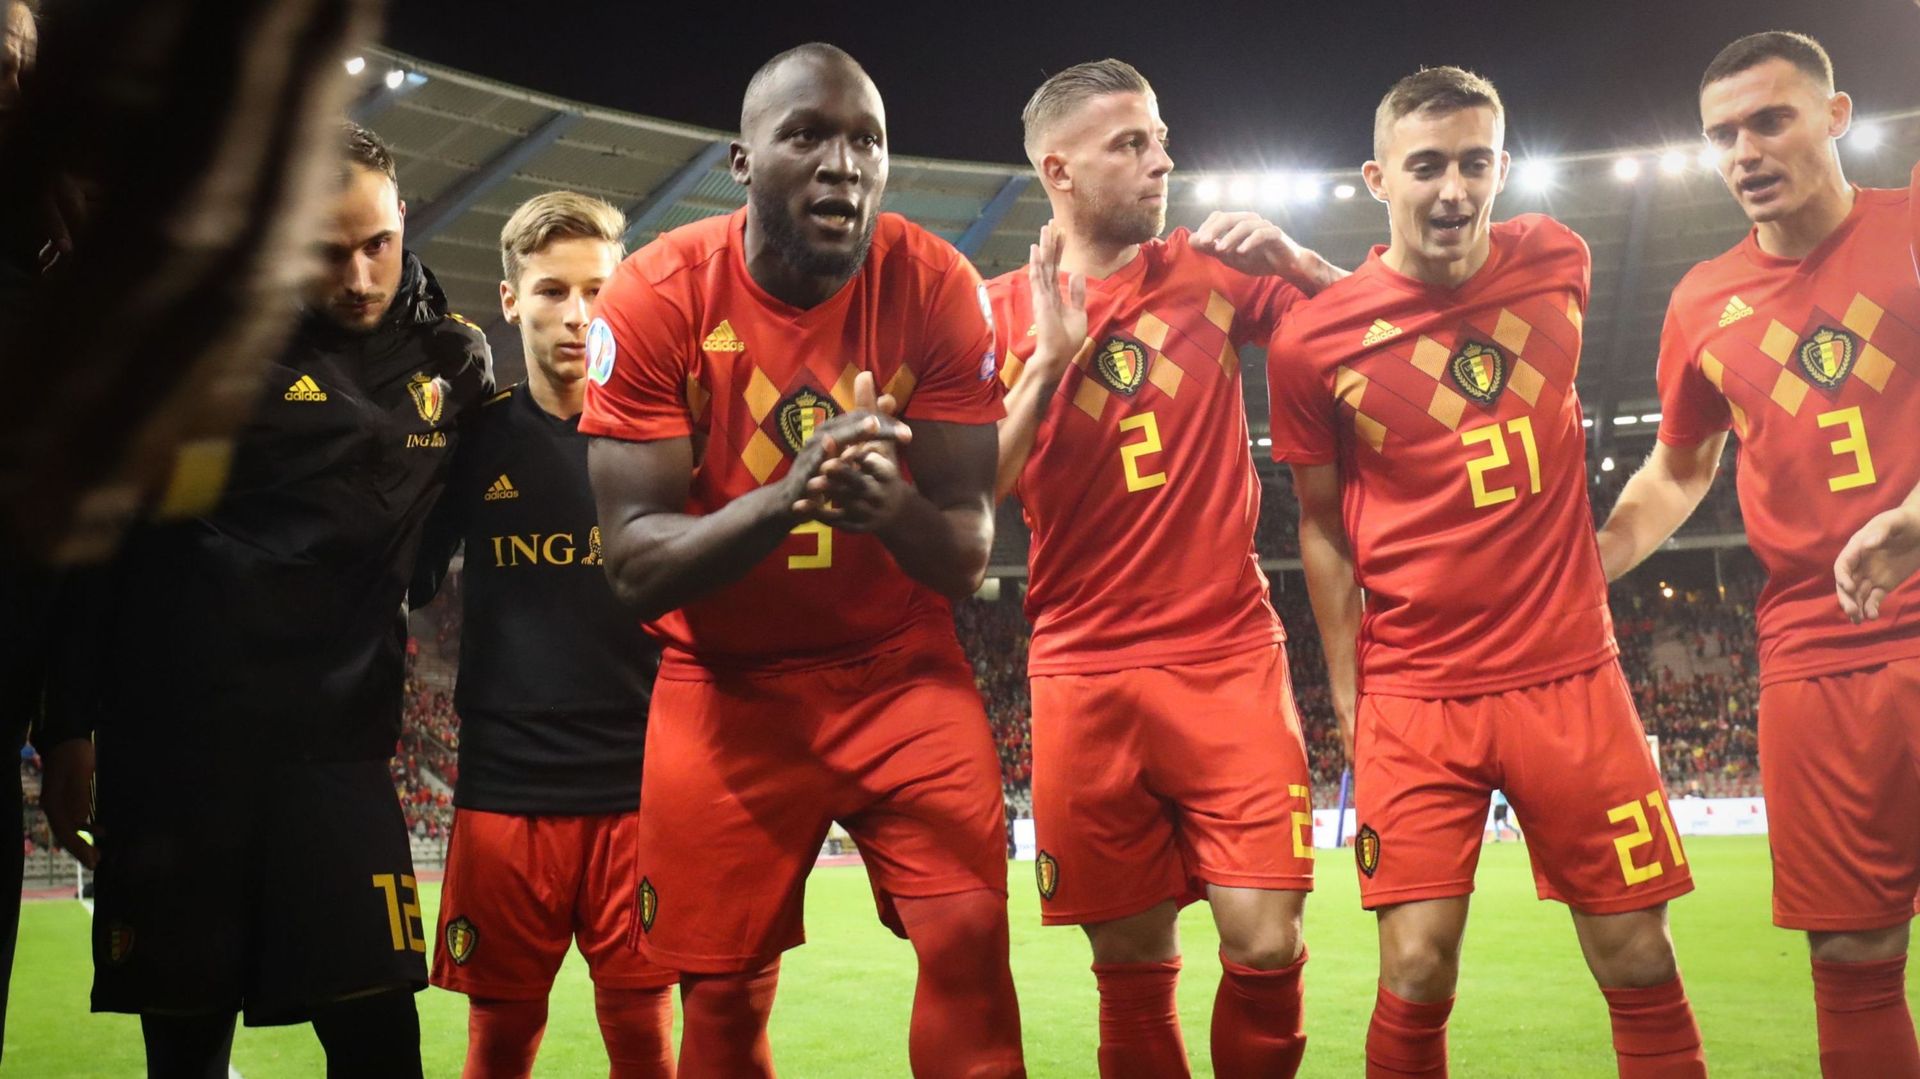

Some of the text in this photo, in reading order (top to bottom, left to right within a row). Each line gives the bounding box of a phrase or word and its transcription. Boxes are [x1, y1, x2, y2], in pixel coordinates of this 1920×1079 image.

[1719, 306, 1753, 328] adidas
[702, 340, 745, 352] adidas
[1362, 327, 1403, 346] adidas
[284, 390, 328, 402] adidas
[406, 433, 430, 448] ING
[1119, 411, 1167, 492] 2
[1816, 405, 1876, 492] 3
[1461, 416, 1541, 508] 21
[484, 489, 519, 501] adidas
[491, 533, 576, 567] ING
[1607, 790, 1685, 886] 21
[372, 873, 426, 952] 12
